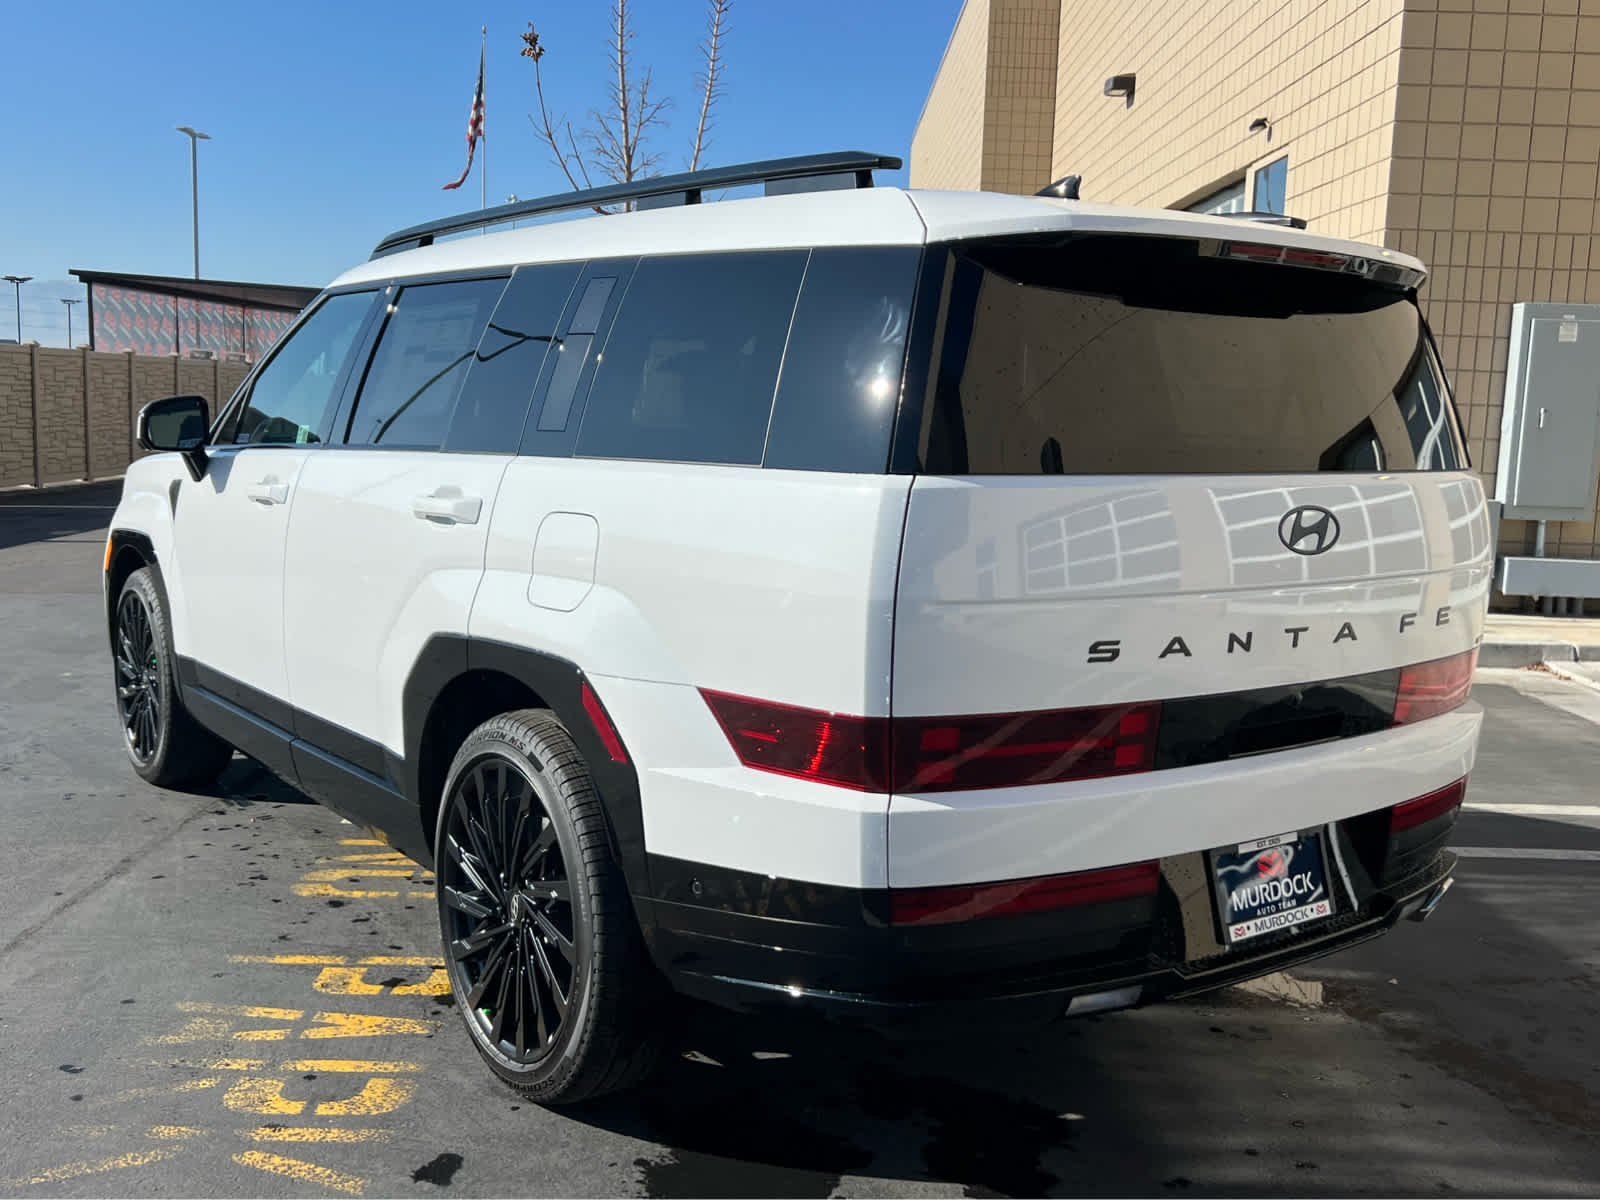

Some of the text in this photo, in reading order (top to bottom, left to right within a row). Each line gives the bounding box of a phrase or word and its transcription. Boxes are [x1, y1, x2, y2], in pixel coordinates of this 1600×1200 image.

[1087, 606, 1451, 663] SANTA FE
[1232, 872, 1314, 911] MURDOCK
[1254, 908, 1309, 932] MURDOCK
[1257, 899, 1297, 916] AUTO TEAM
